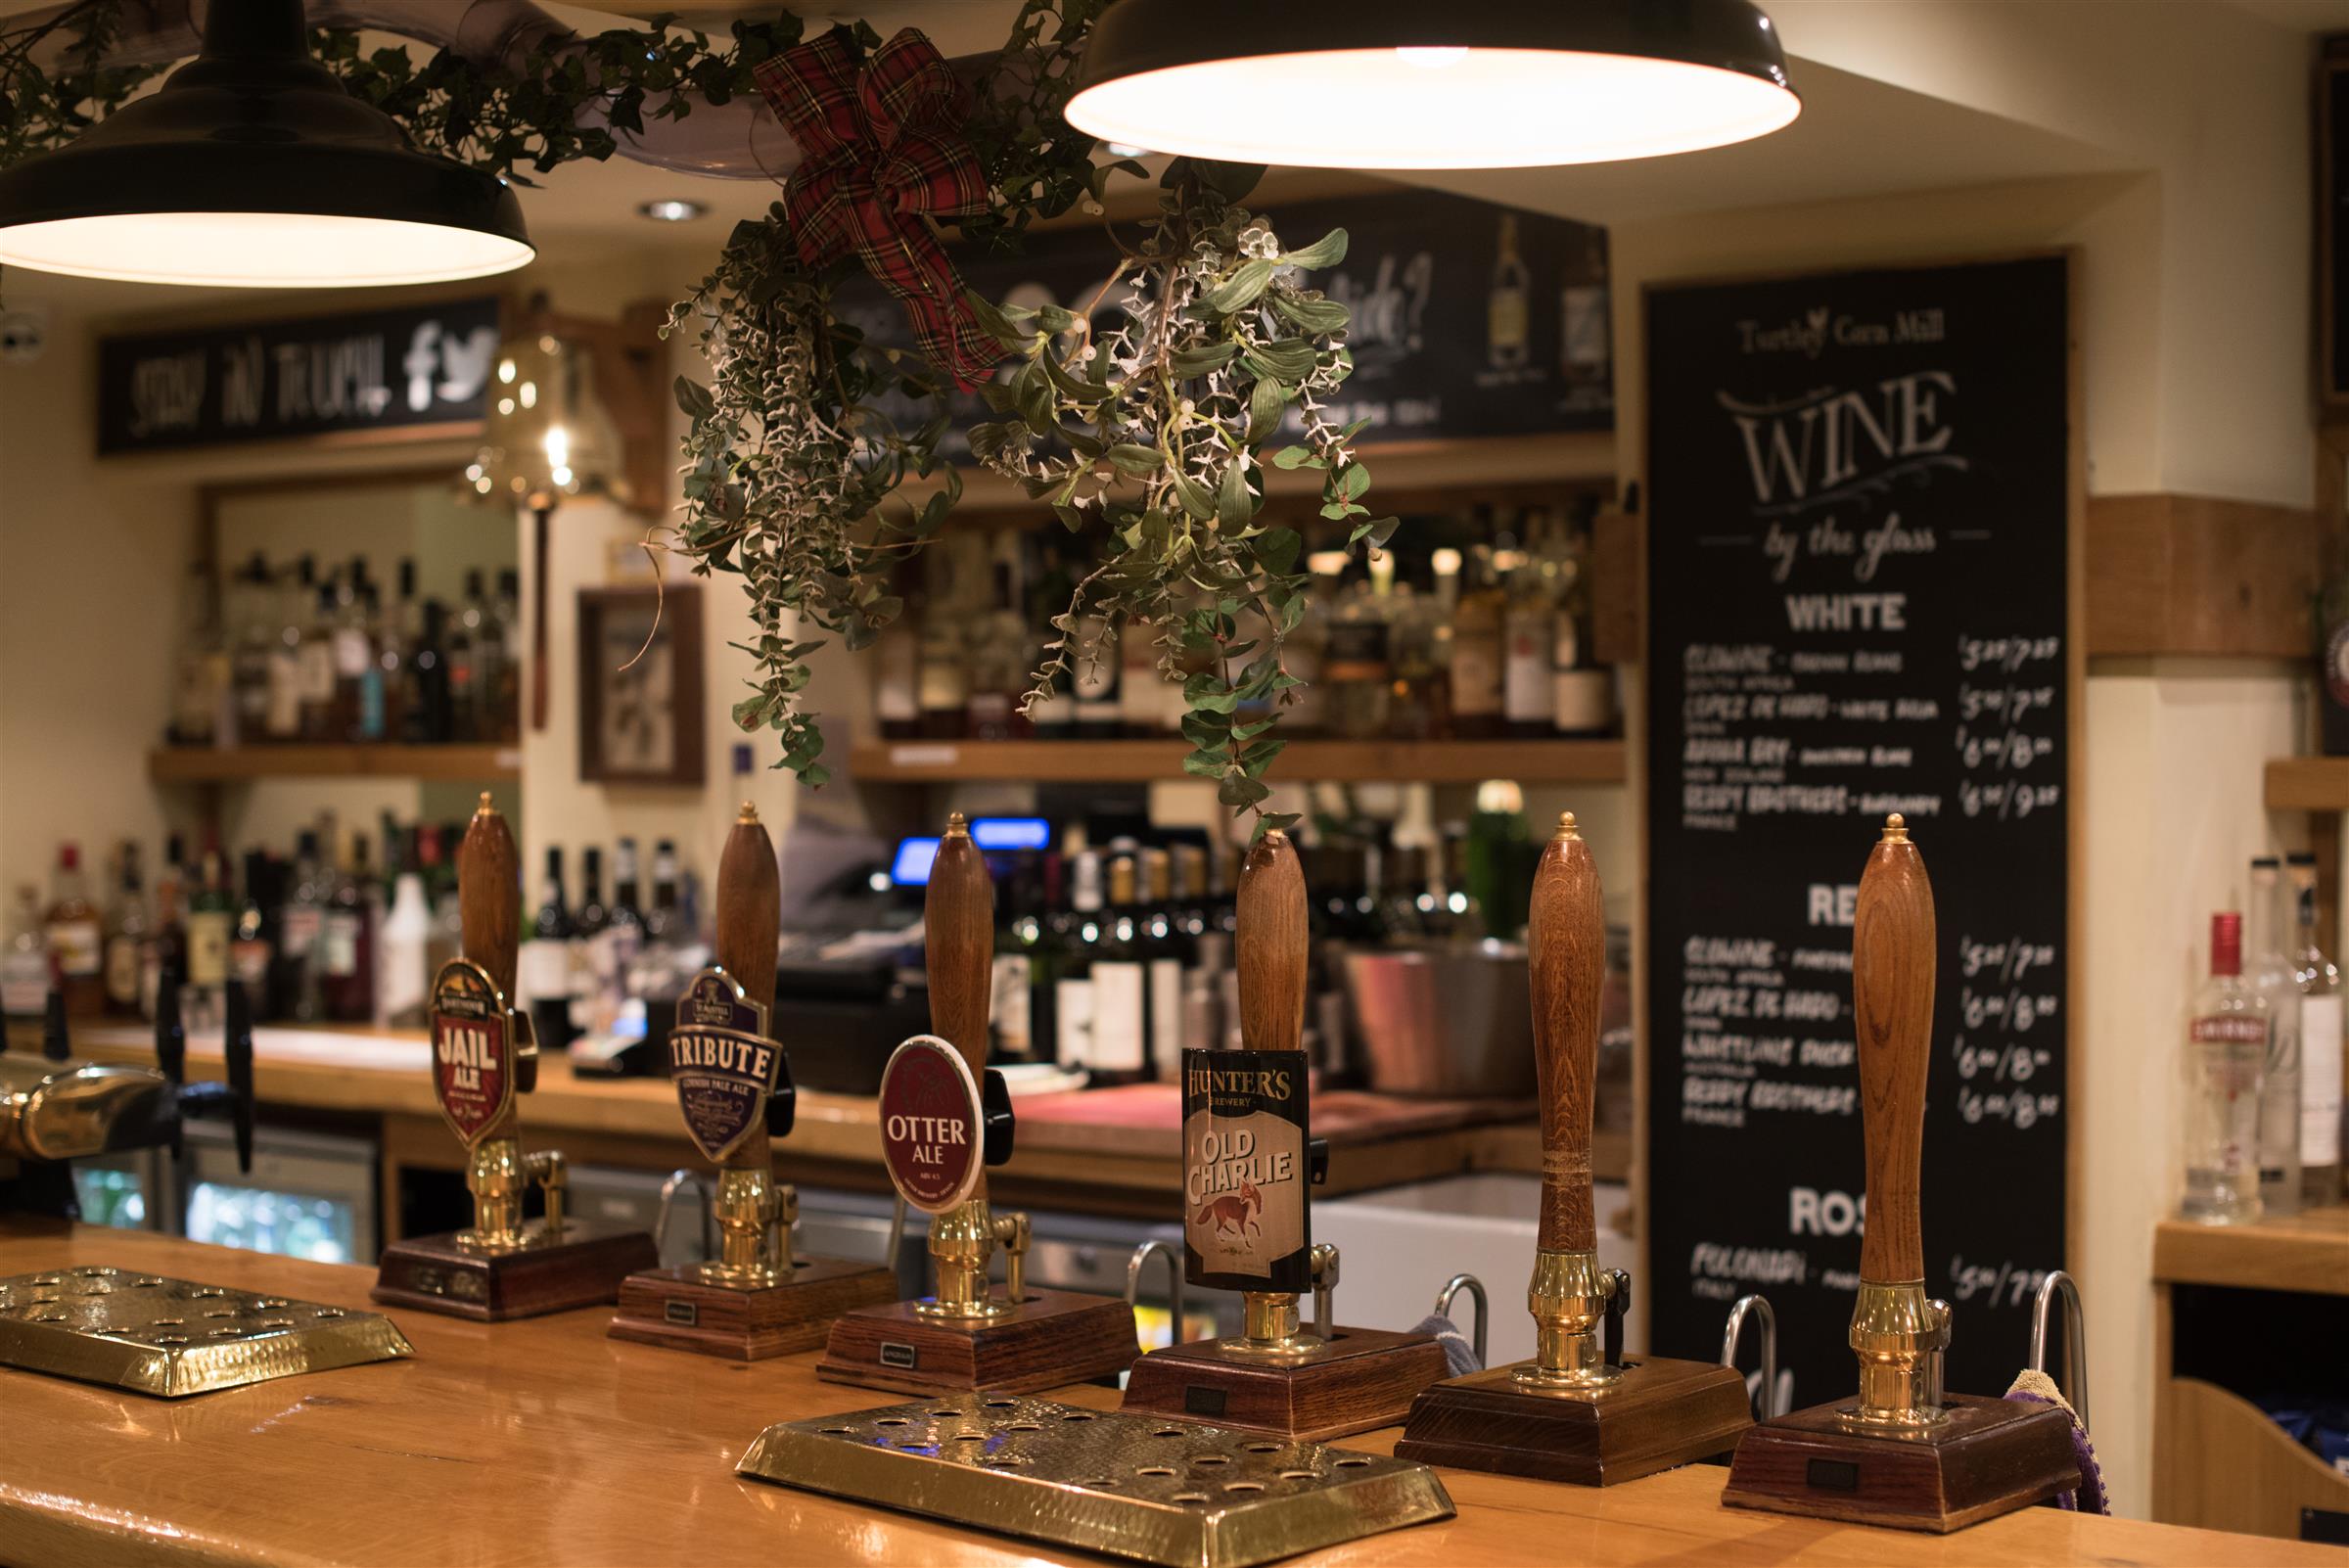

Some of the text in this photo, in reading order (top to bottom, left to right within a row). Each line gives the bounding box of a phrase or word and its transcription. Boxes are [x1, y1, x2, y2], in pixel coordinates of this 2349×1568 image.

[1895, 309, 1945, 343] Mill
[1734, 371, 1957, 502] WINE
[1764, 512, 1937, 582] by the glass
[1785, 593, 1908, 631] WHITE
[1807, 884, 1858, 926] RE
[438, 1027, 497, 1072] JAIL
[670, 1036, 771, 1080] TRIBUTE
[453, 1067, 482, 1091] ALE
[732, 1083, 750, 1096] ALE
[1188, 1068, 1292, 1101] HUNTER'S
[1209, 1096, 1252, 1107] BREWERY
[887, 1114, 967, 1145] OTTER
[1201, 1130, 1255, 1165] OLD
[912, 1144, 944, 1165] ALE
[1187, 1151, 1293, 1206] CHARLIE
[1789, 1186, 1866, 1236] RO
